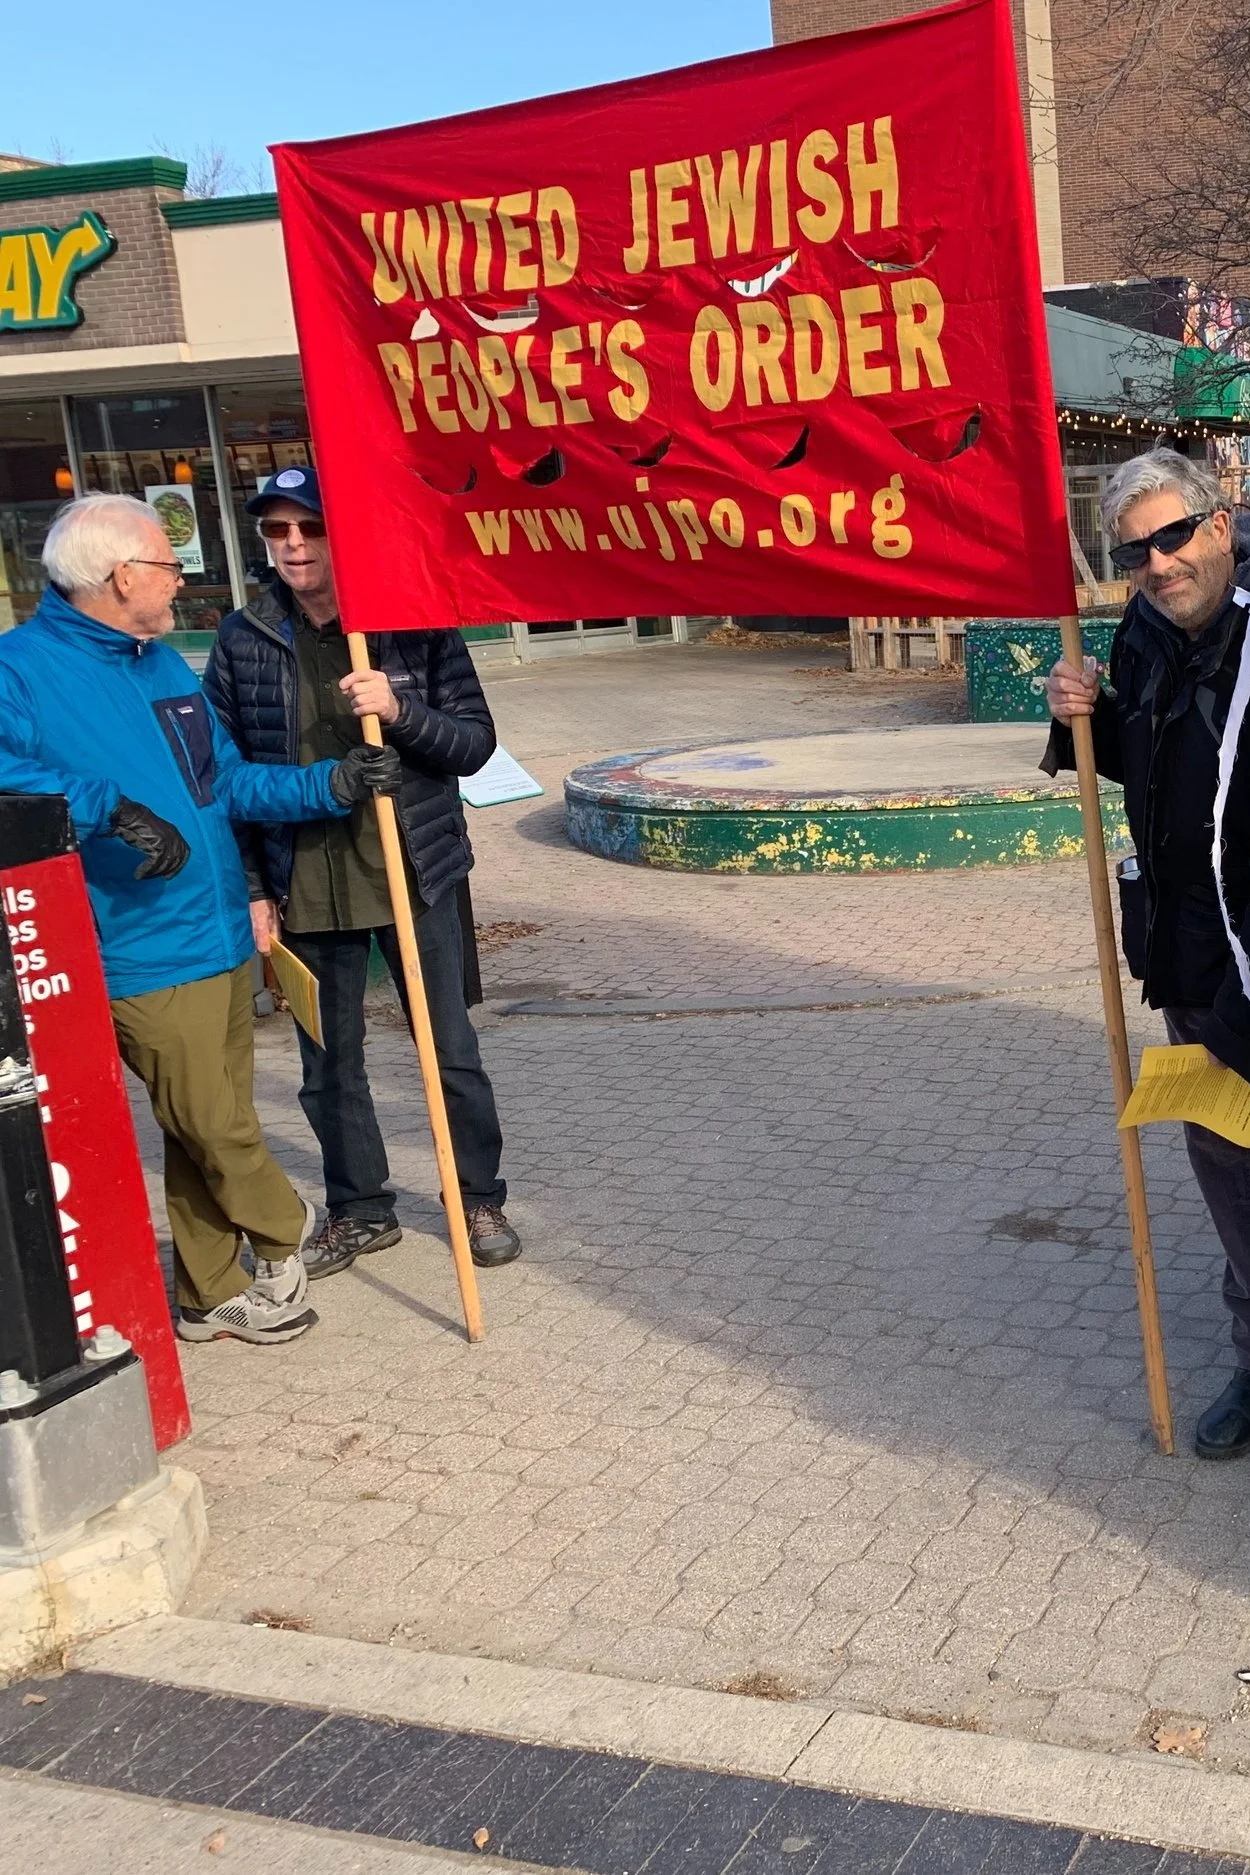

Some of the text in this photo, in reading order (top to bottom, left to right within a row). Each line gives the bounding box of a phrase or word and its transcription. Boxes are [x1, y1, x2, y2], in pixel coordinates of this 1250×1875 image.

[361, 115, 899, 304] UNITED JEWISH
[378, 278, 951, 435] PEOPLE'S ORDER
[464, 474, 914, 561] www.ujpo.org
